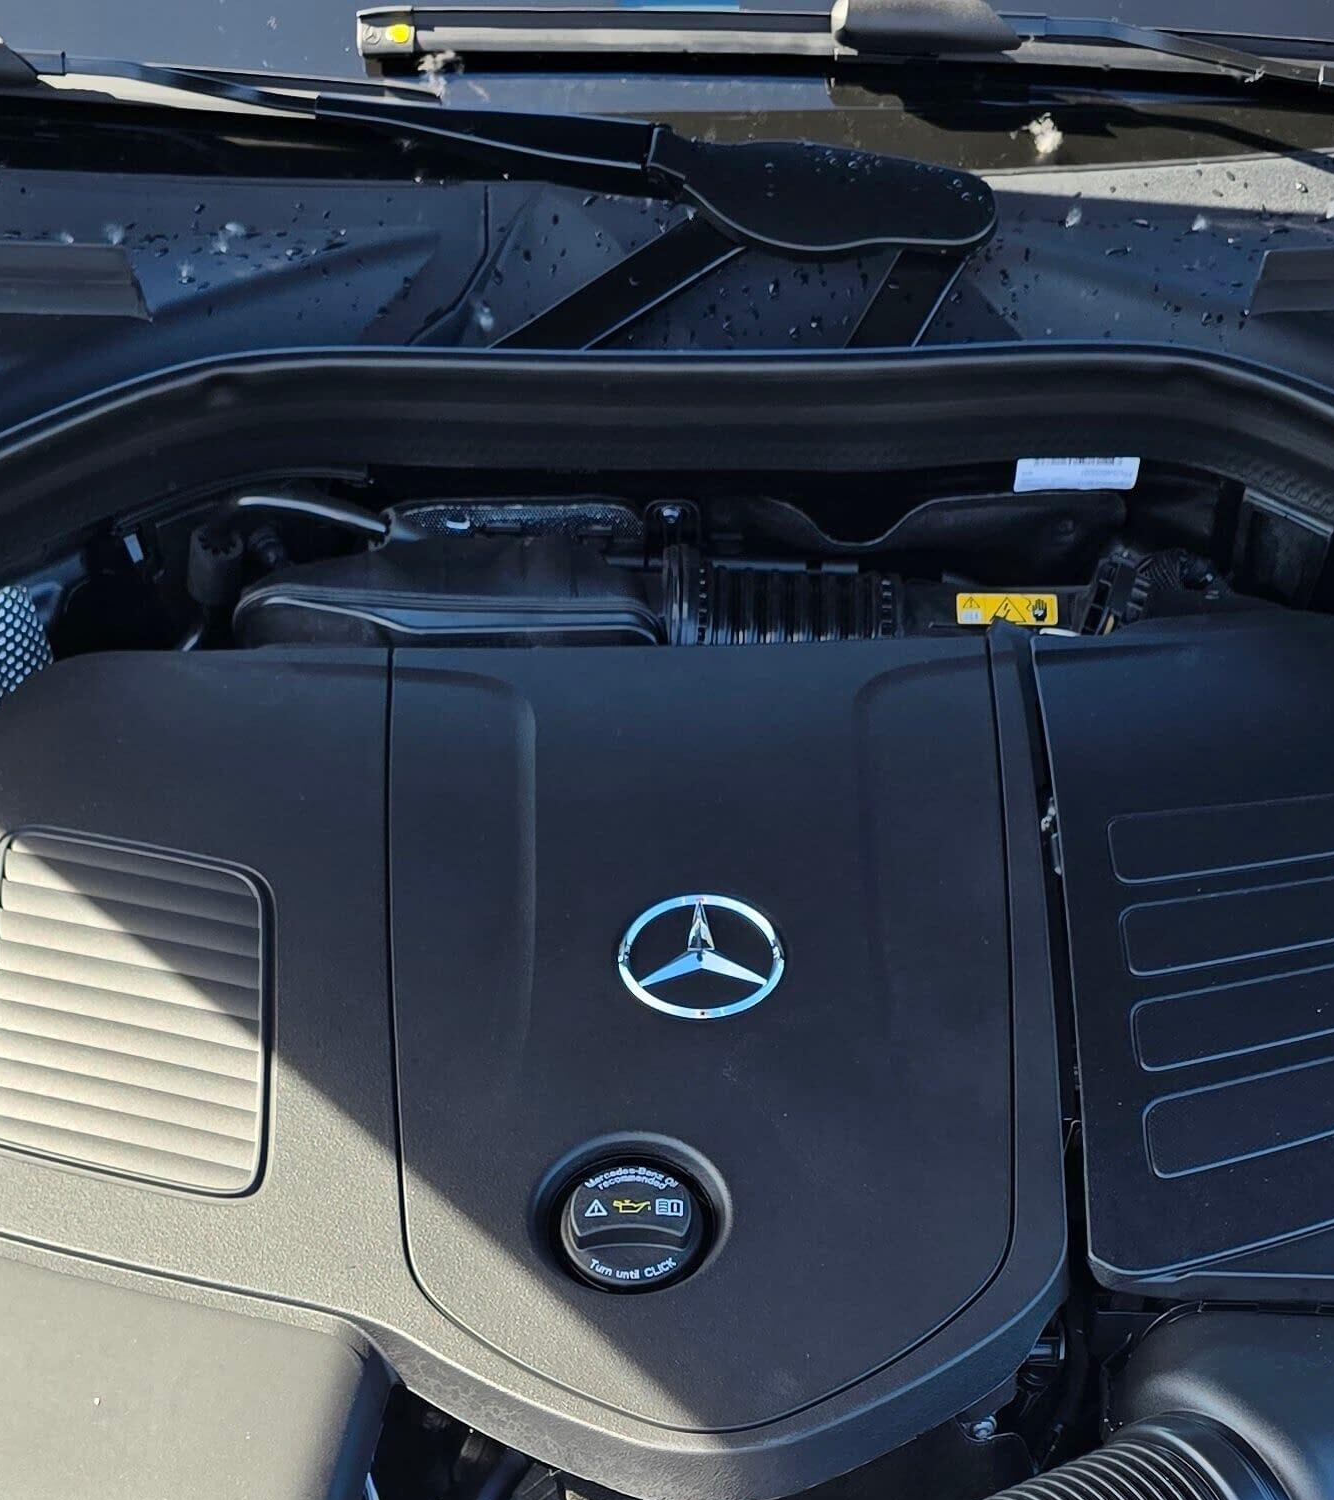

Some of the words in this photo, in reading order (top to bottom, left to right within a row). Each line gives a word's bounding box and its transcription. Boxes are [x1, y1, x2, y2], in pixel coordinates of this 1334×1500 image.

[584, 1167, 664, 1188] Mercedes-Benz
[664, 1177, 679, 1188] Oil
[597, 1174, 667, 1190] recommended
[590, 1258, 612, 1276] Turn
[616, 1269, 640, 1279] until
[644, 1257, 677, 1277] CLICK
